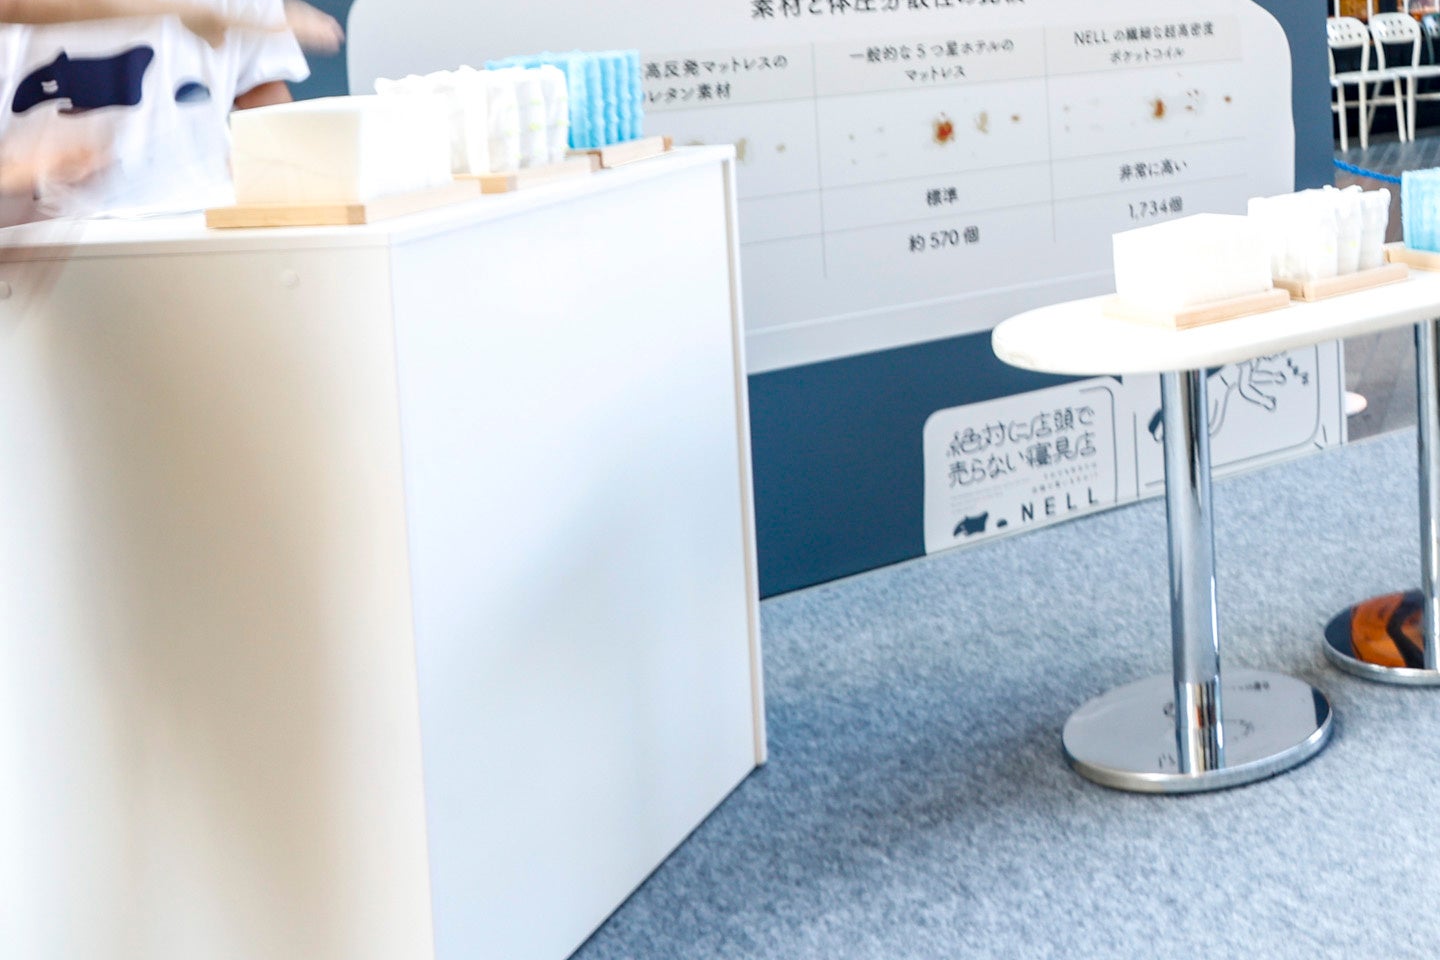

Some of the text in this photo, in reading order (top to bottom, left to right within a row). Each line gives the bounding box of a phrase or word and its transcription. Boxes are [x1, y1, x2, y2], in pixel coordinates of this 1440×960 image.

[905, 65, 966, 81] マットレス
[643, 81, 731, 104] レタン素材
[1118, 158, 1189, 182] 非常に高い
[925, 186, 959, 208] 標準
[1128, 195, 1184, 221] 1,734個
[946, 405, 1095, 458] 絶対に店頭で
[1020, 487, 1100, 523] NELL
